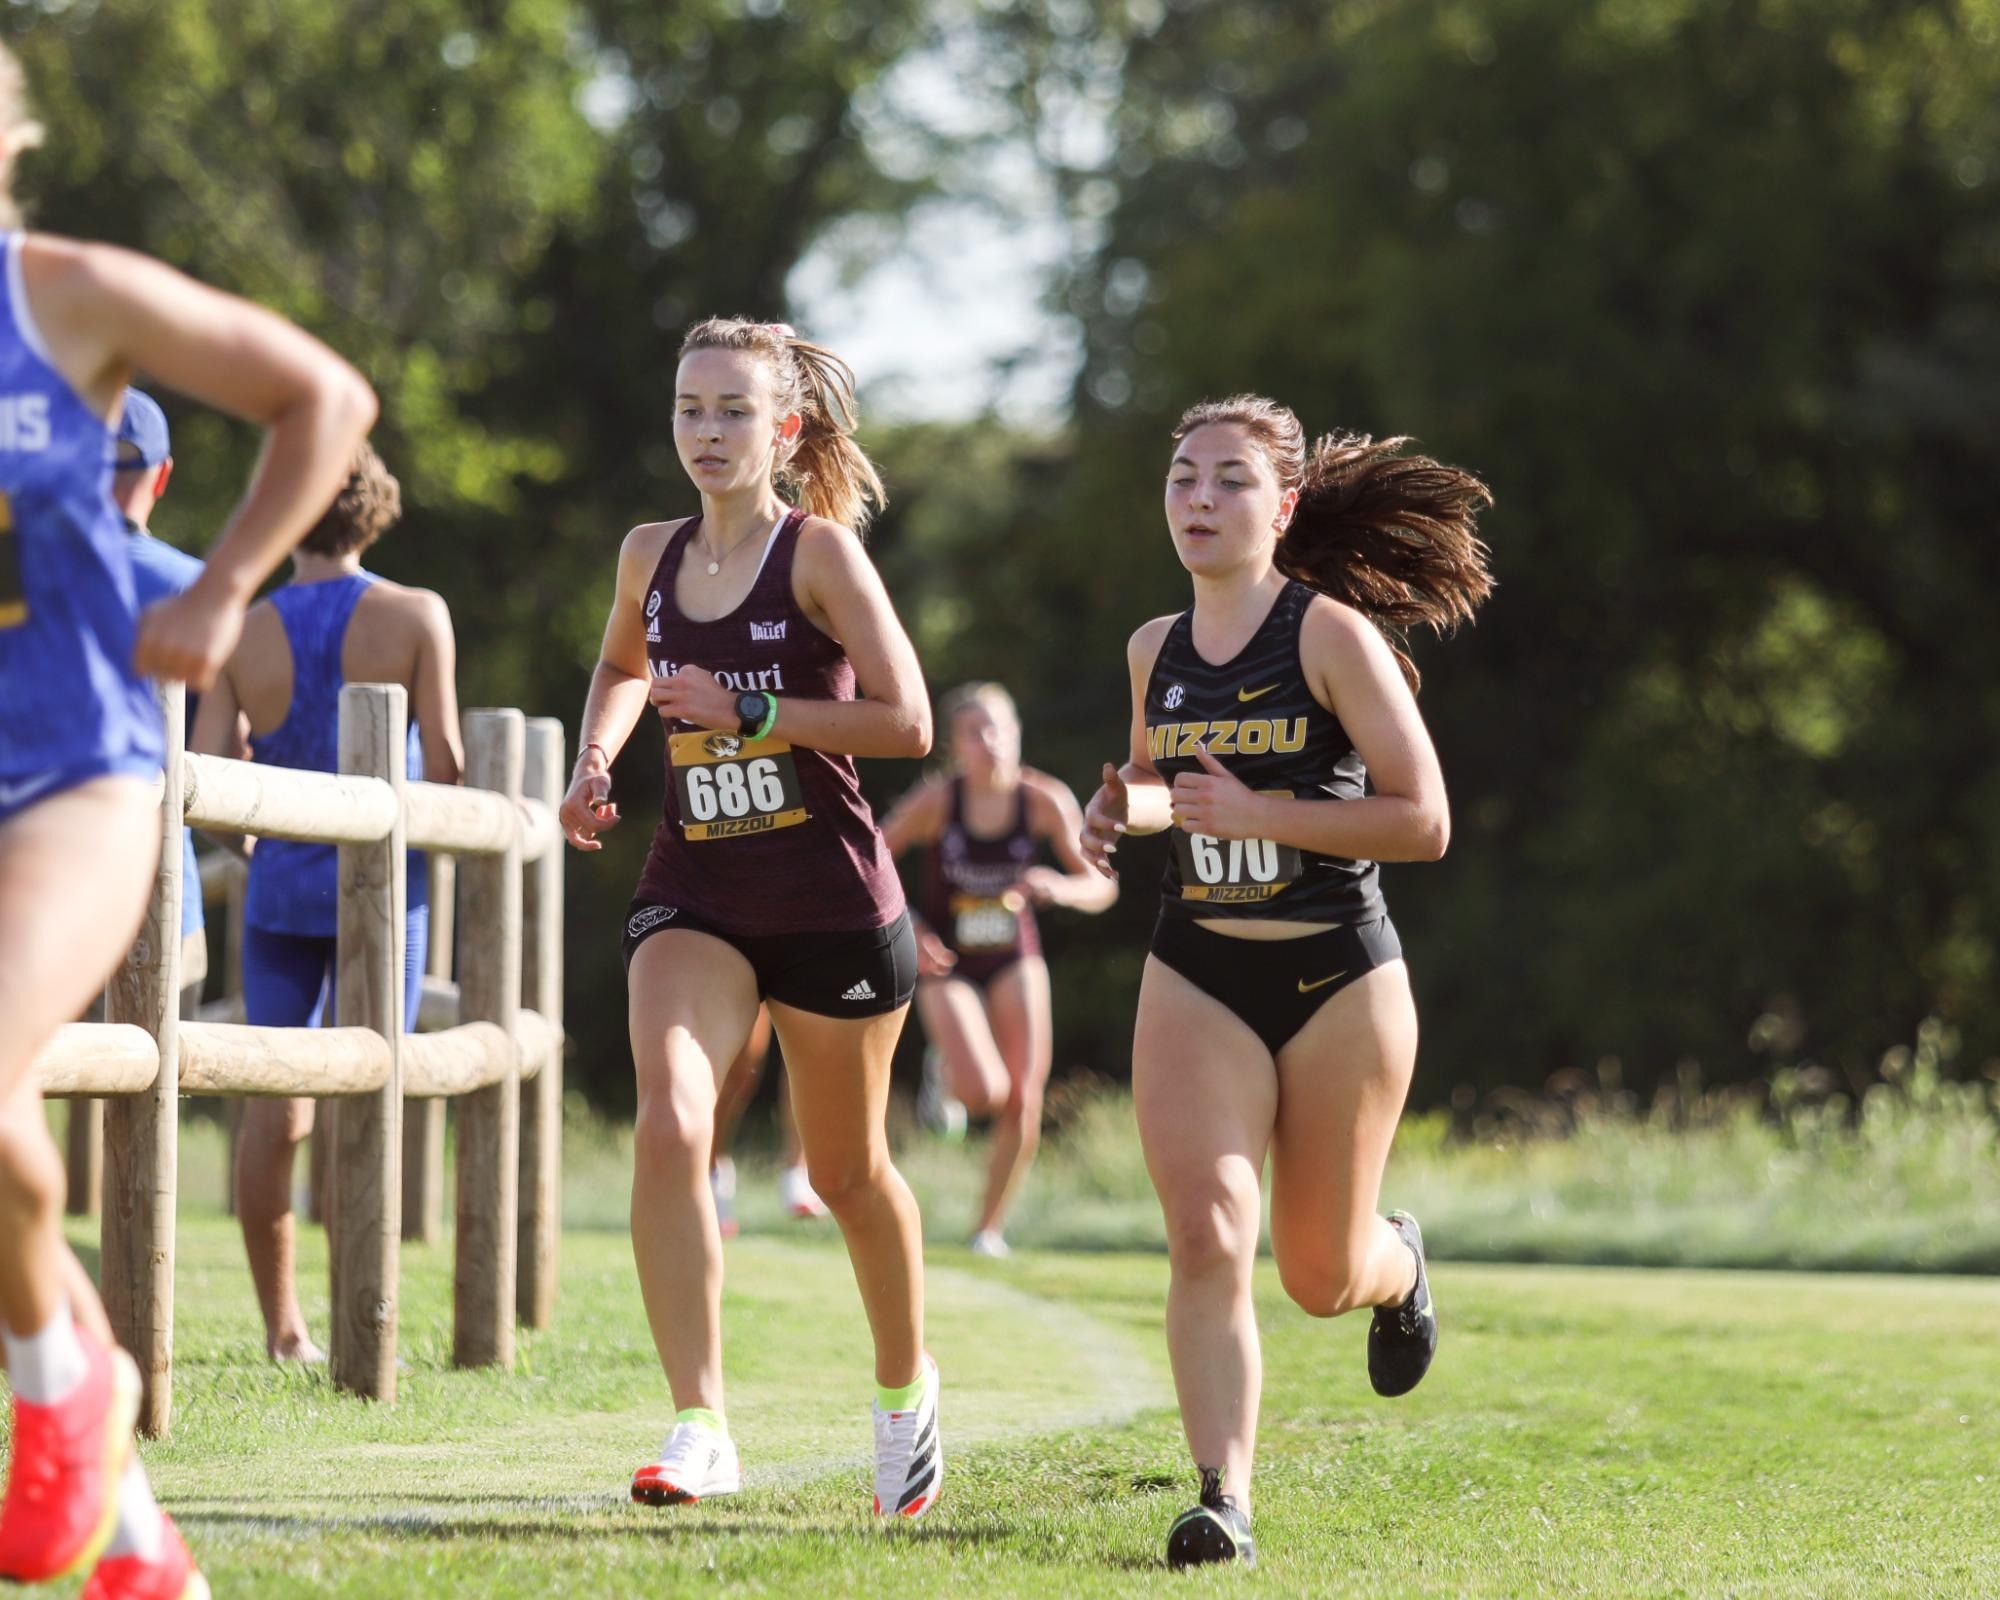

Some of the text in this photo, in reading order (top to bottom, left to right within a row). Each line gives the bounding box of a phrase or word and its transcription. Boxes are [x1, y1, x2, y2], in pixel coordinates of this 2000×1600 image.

[750, 620, 786, 641] VALLEY
[648, 659, 785, 691] Miouri
[1164, 685, 1184, 710] SEC
[1146, 717, 1307, 761] MIZZOU
[686, 758, 785, 821] 686
[706, 815, 775, 837] MIZZOU
[1190, 833, 1279, 884] 670
[1206, 886, 1272, 900] MIZZOU
[841, 991, 877, 1000] adidas
